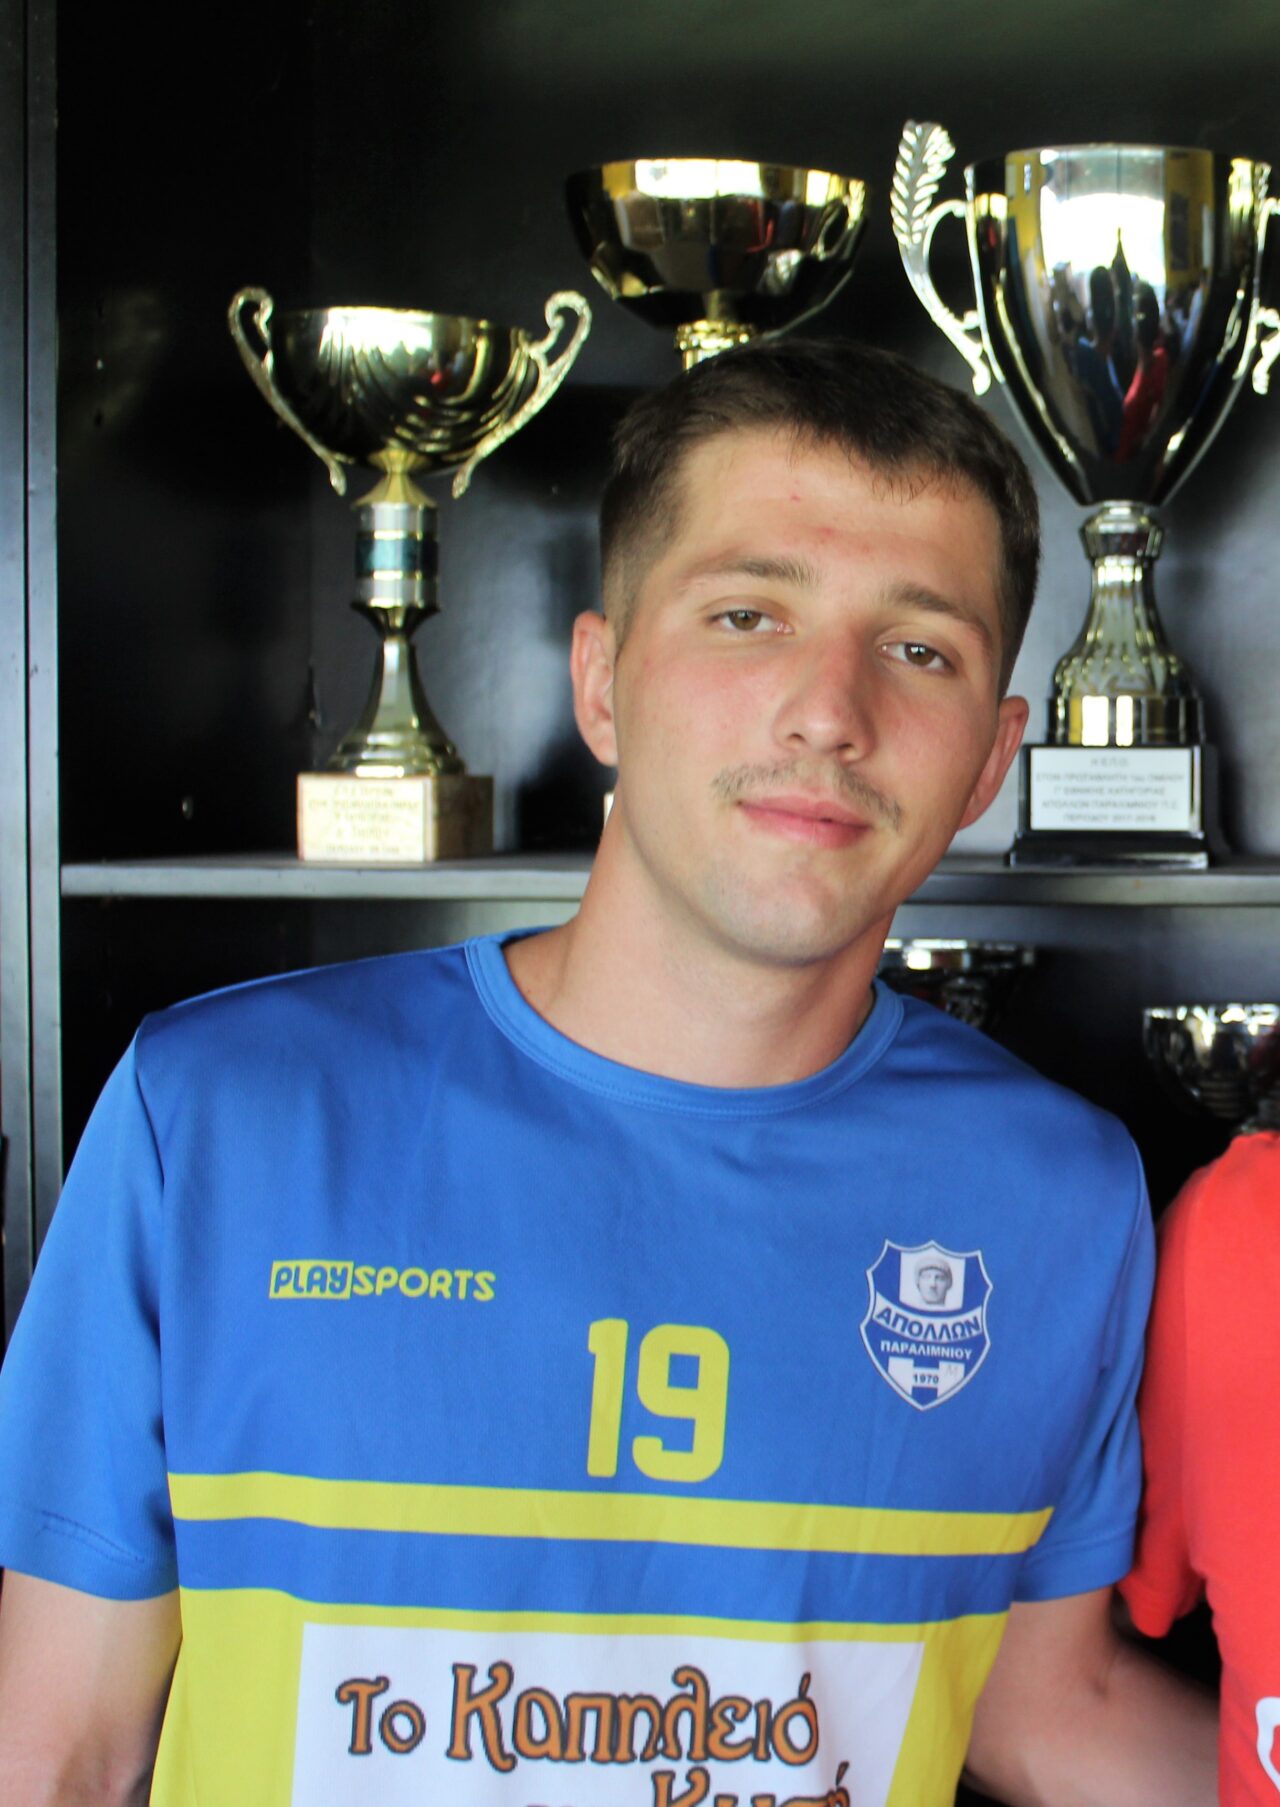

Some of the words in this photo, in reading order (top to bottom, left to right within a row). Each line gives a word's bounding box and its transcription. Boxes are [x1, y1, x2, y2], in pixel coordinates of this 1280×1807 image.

[876, 1306, 982, 1341] ΑΠΟΛΛΩΝ
[880, 1340, 972, 1360] ΠΑΡΑΛΙΜΝΙΟΥ
[913, 1374, 939, 1385] 1970
[587, 1317, 730, 1483] 19
[336, 1675, 426, 1755] Το
[447, 1660, 820, 1773] Καπηλειό
